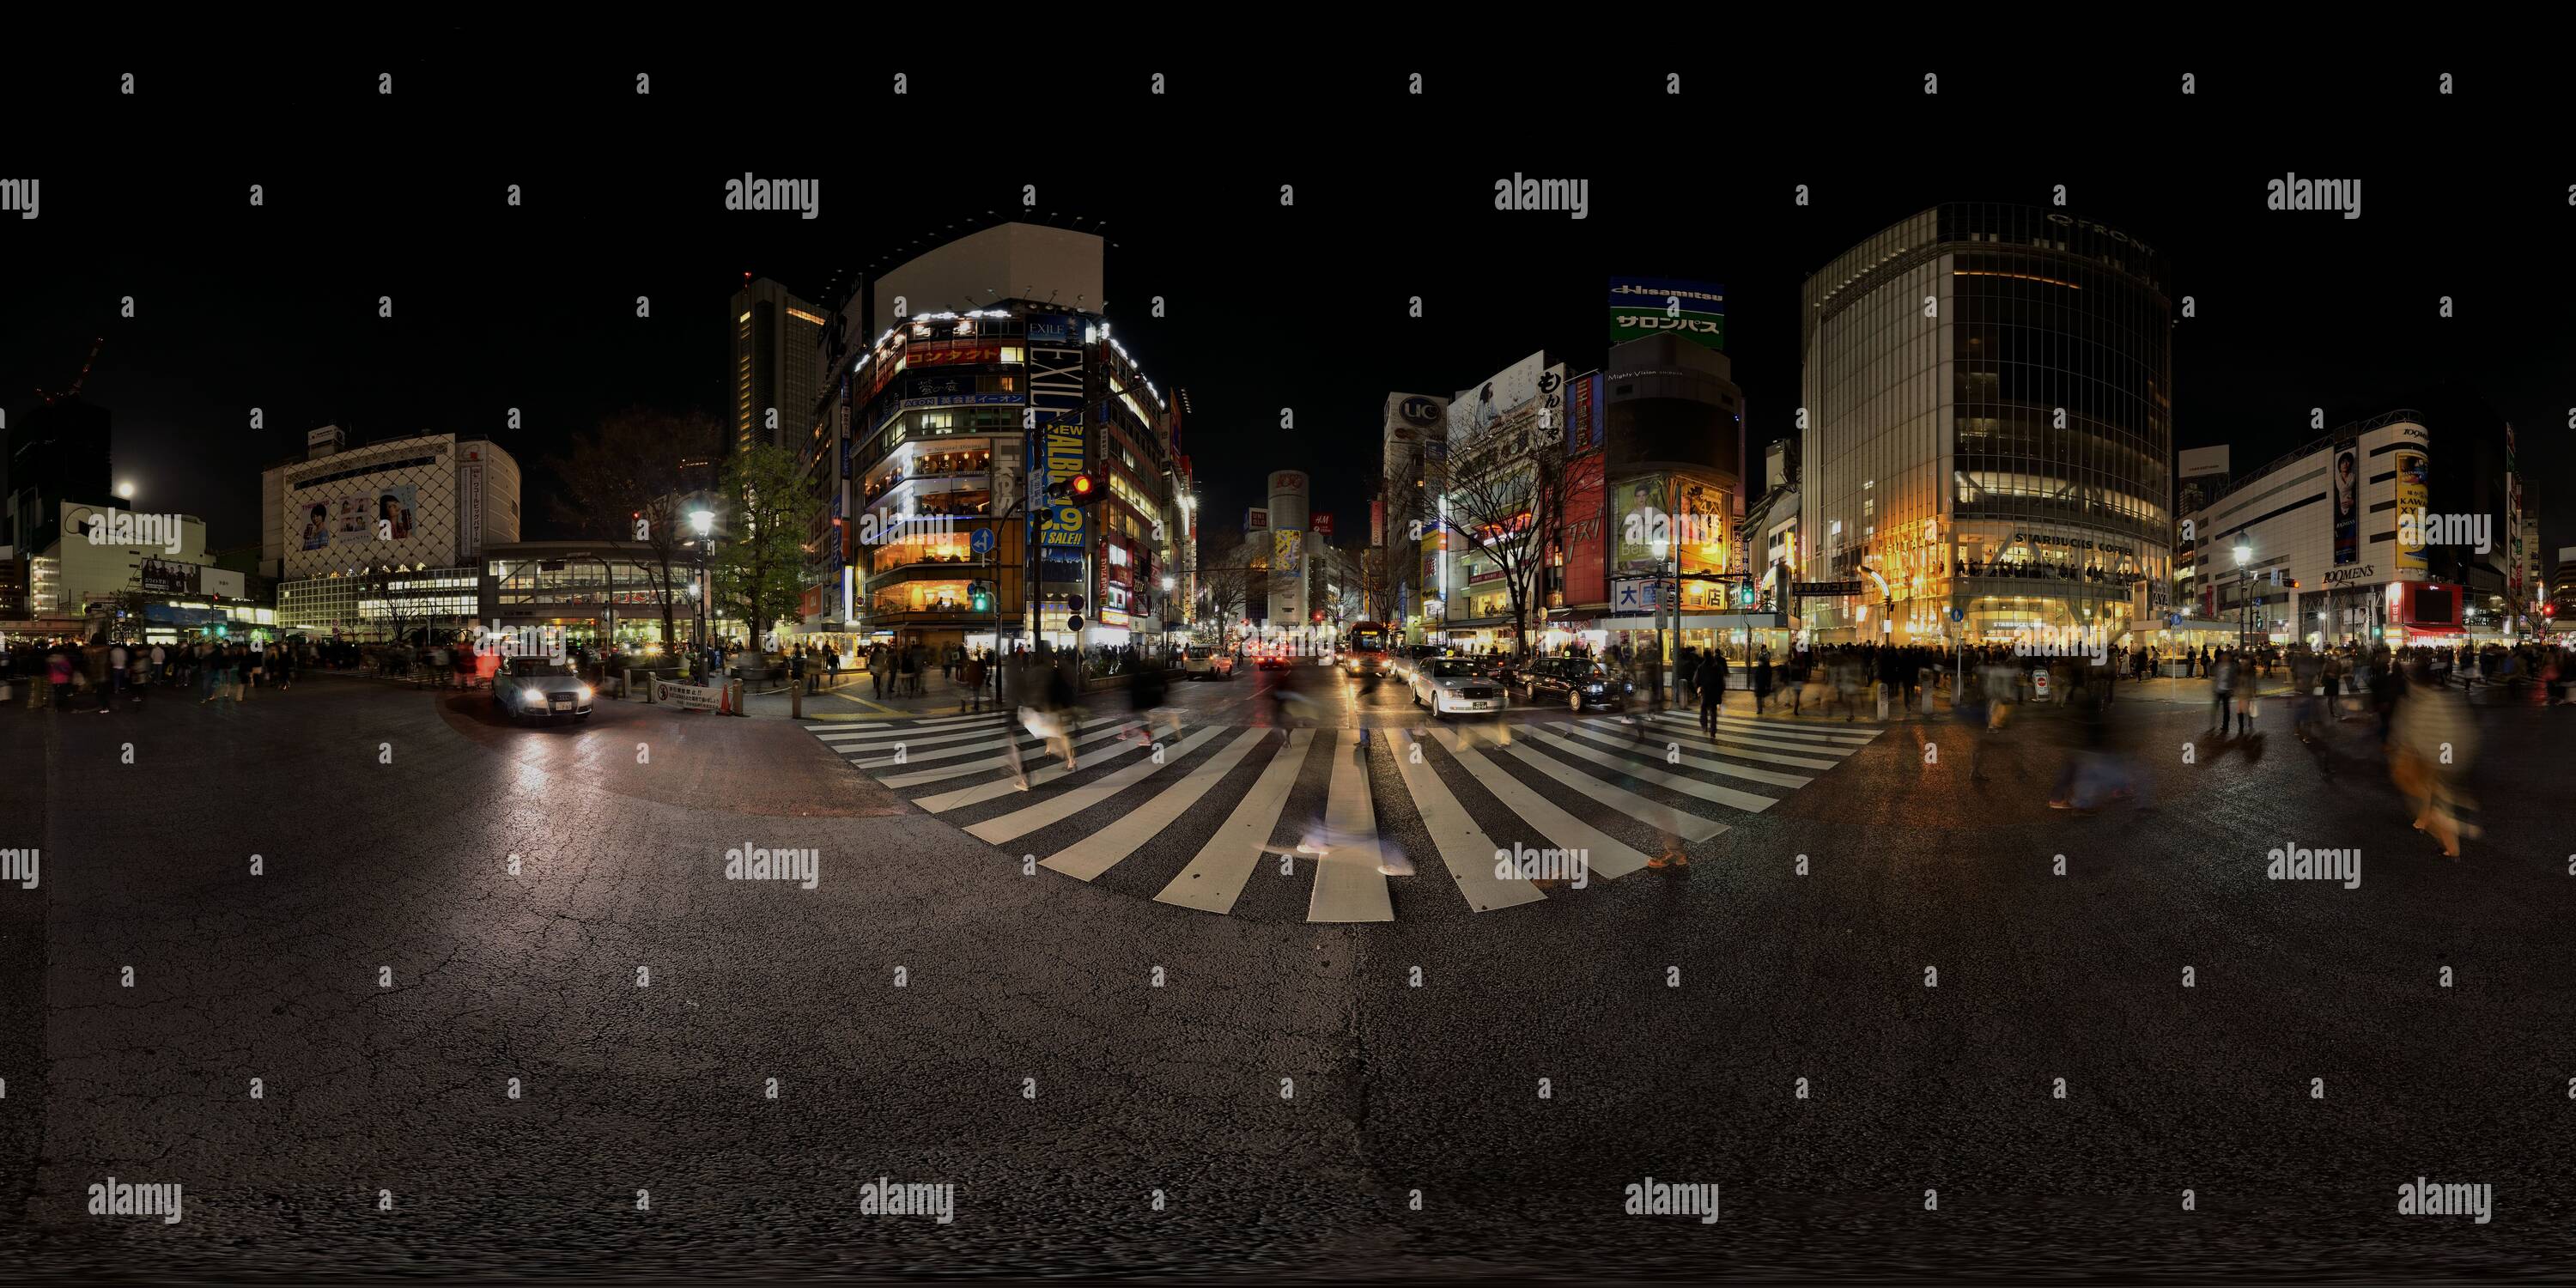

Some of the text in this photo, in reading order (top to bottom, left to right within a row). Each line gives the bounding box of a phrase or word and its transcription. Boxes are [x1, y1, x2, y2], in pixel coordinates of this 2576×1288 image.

[1611, 285, 1723, 301] Hisamitsu
[1030, 323, 1065, 334] EXILE
[1616, 315, 1720, 335] サロンパス
[908, 348, 1001, 366] コンタクト
[1607, 372, 1632, 381] Mighty
[1030, 347, 1084, 425] EXILE
[905, 398, 935, 407] AEON
[1048, 425, 1084, 436] NEW
[2015, 533, 2093, 550] STARBUCKS
[2323, 564, 2375, 587] 109MEN'S
